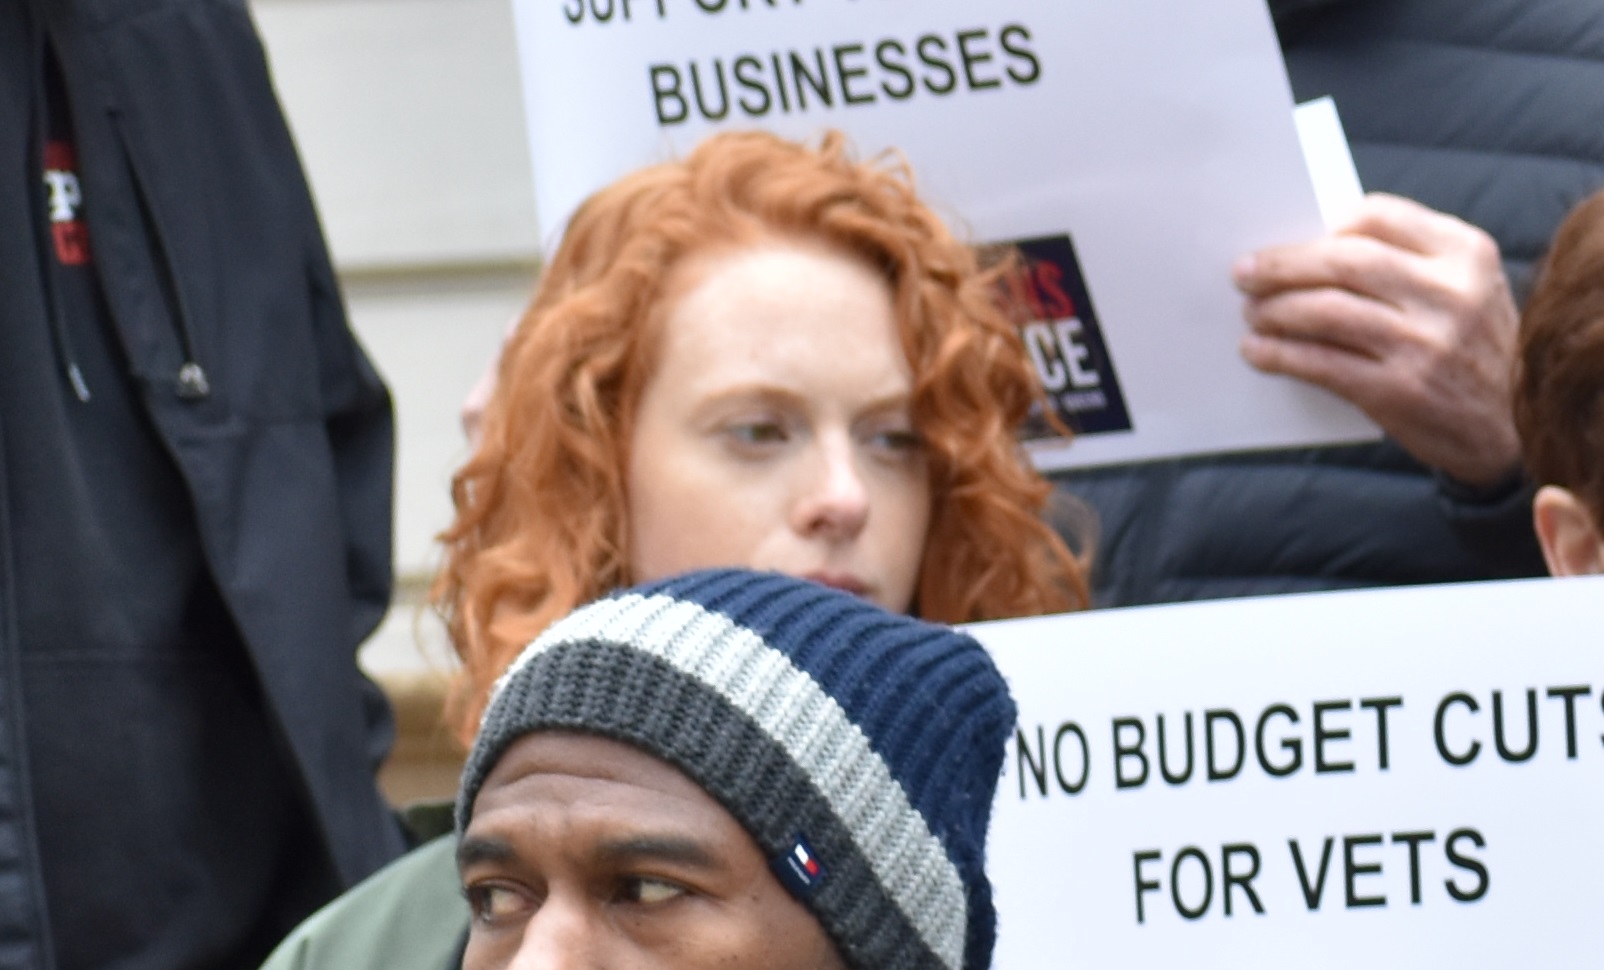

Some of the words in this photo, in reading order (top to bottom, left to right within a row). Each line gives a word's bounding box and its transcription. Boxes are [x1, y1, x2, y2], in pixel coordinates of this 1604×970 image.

[648, 24, 1043, 127] BUSINESSES
[1014, 720, 1092, 800] NO
[1111, 695, 1404, 790] BUDGET
[1132, 842, 1267, 924] FOR
[1286, 827, 1491, 912] VETS
